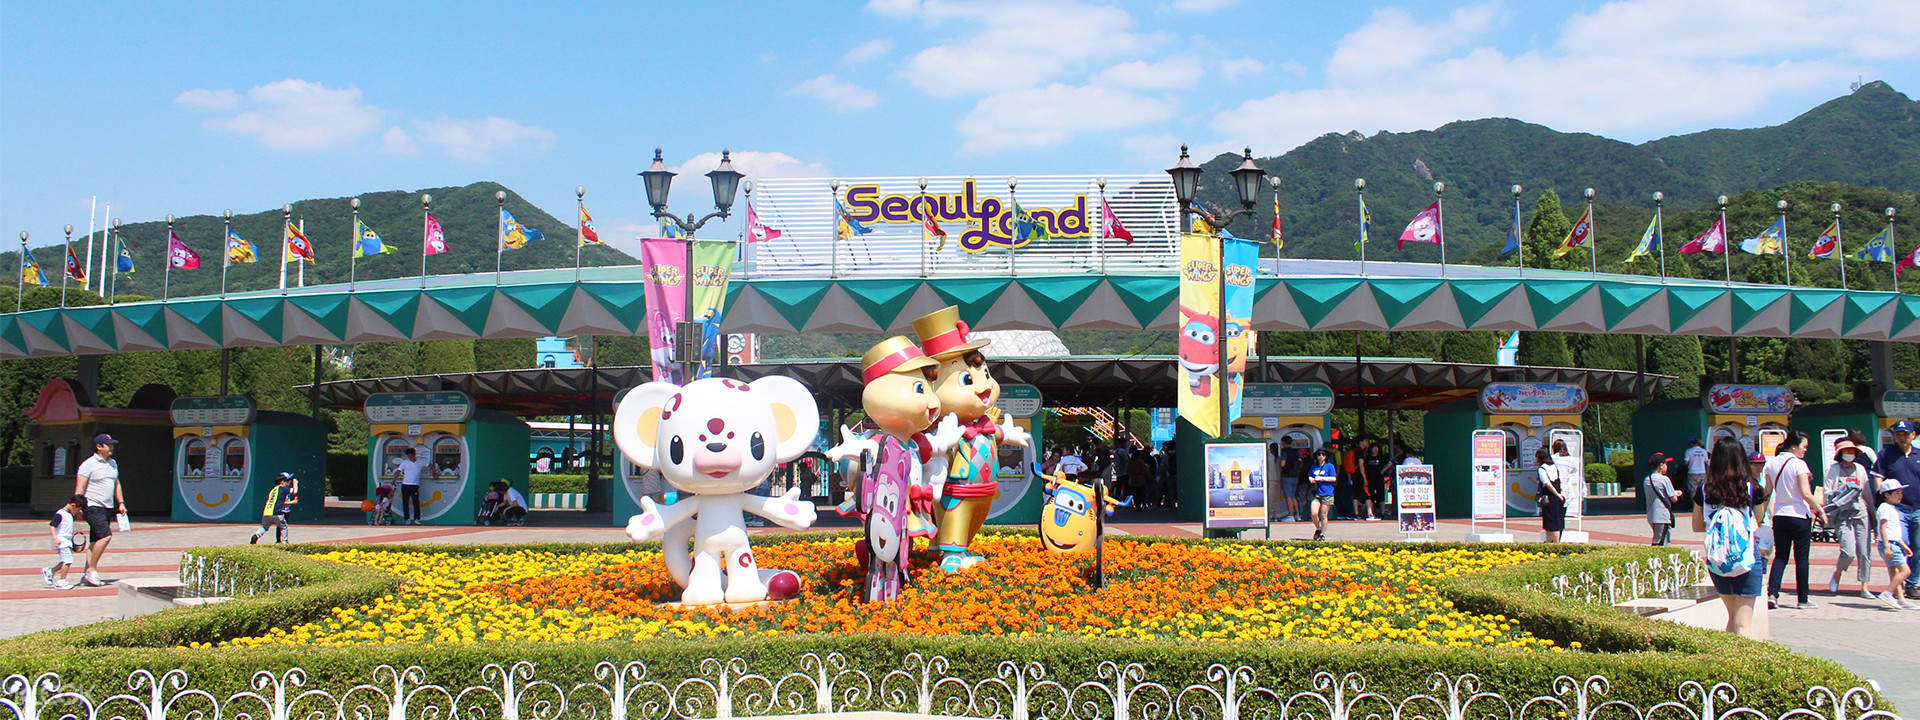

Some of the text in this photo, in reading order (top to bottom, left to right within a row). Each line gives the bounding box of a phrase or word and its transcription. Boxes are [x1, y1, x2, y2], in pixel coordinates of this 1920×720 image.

[846, 179, 978, 224] Seoul
[650, 265, 679, 276] SUPER
[696, 265, 725, 276] SUPER
[1186, 261, 1214, 272] SUPER
[1226, 265, 1252, 276] SUPER
[693, 274, 727, 286] WINGS
[1184, 270, 1217, 281] WINGS
[1225, 274, 1254, 286] WINGS
